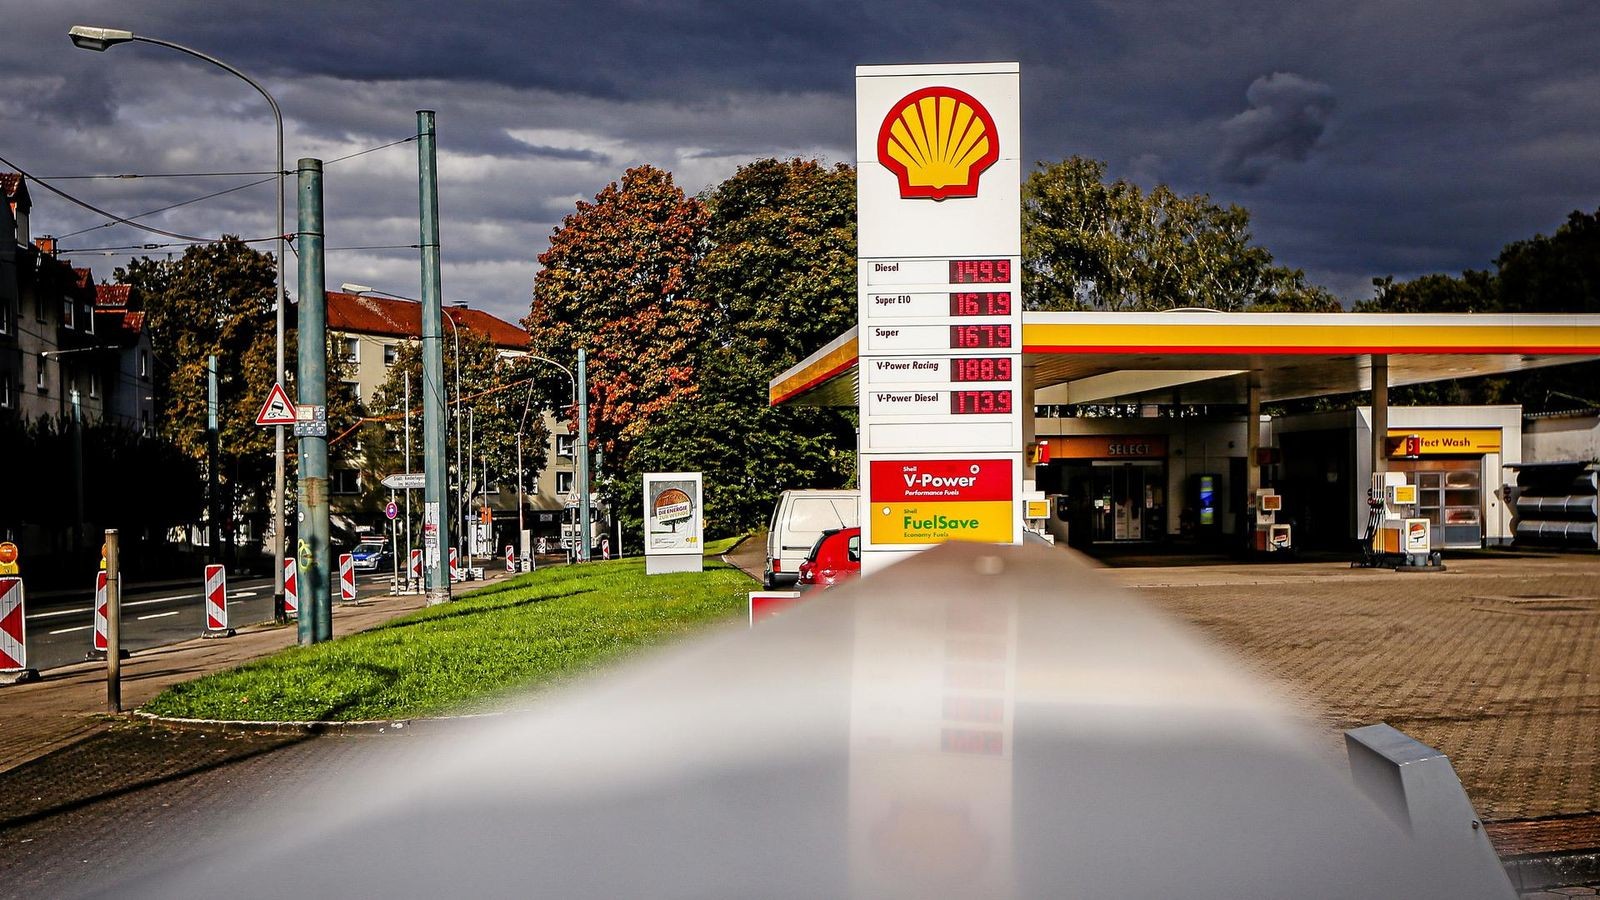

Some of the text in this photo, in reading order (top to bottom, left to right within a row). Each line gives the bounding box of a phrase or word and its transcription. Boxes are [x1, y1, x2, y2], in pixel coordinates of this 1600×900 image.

[875, 263, 899, 272] Diesel
[957, 261, 1010, 283] 149.9
[875, 295, 911, 306] Super E10
[957, 293, 1010, 315] 161.9
[875, 328, 899, 338] Super
[957, 326, 1010, 347] 167.9
[876, 361, 939, 371] V-Power Racing
[957, 358, 1011, 381] 188.9
[877, 393, 939, 402] V-Power Diesel
[958, 391, 1011, 413] 173.9
[1408, 440, 1414, 452] 5
[1420, 437, 1471, 447] fect Wash
[1109, 444, 1152, 455] SELECT
[904, 473, 977, 487] V-Power
[904, 515, 979, 530] FuelSave
